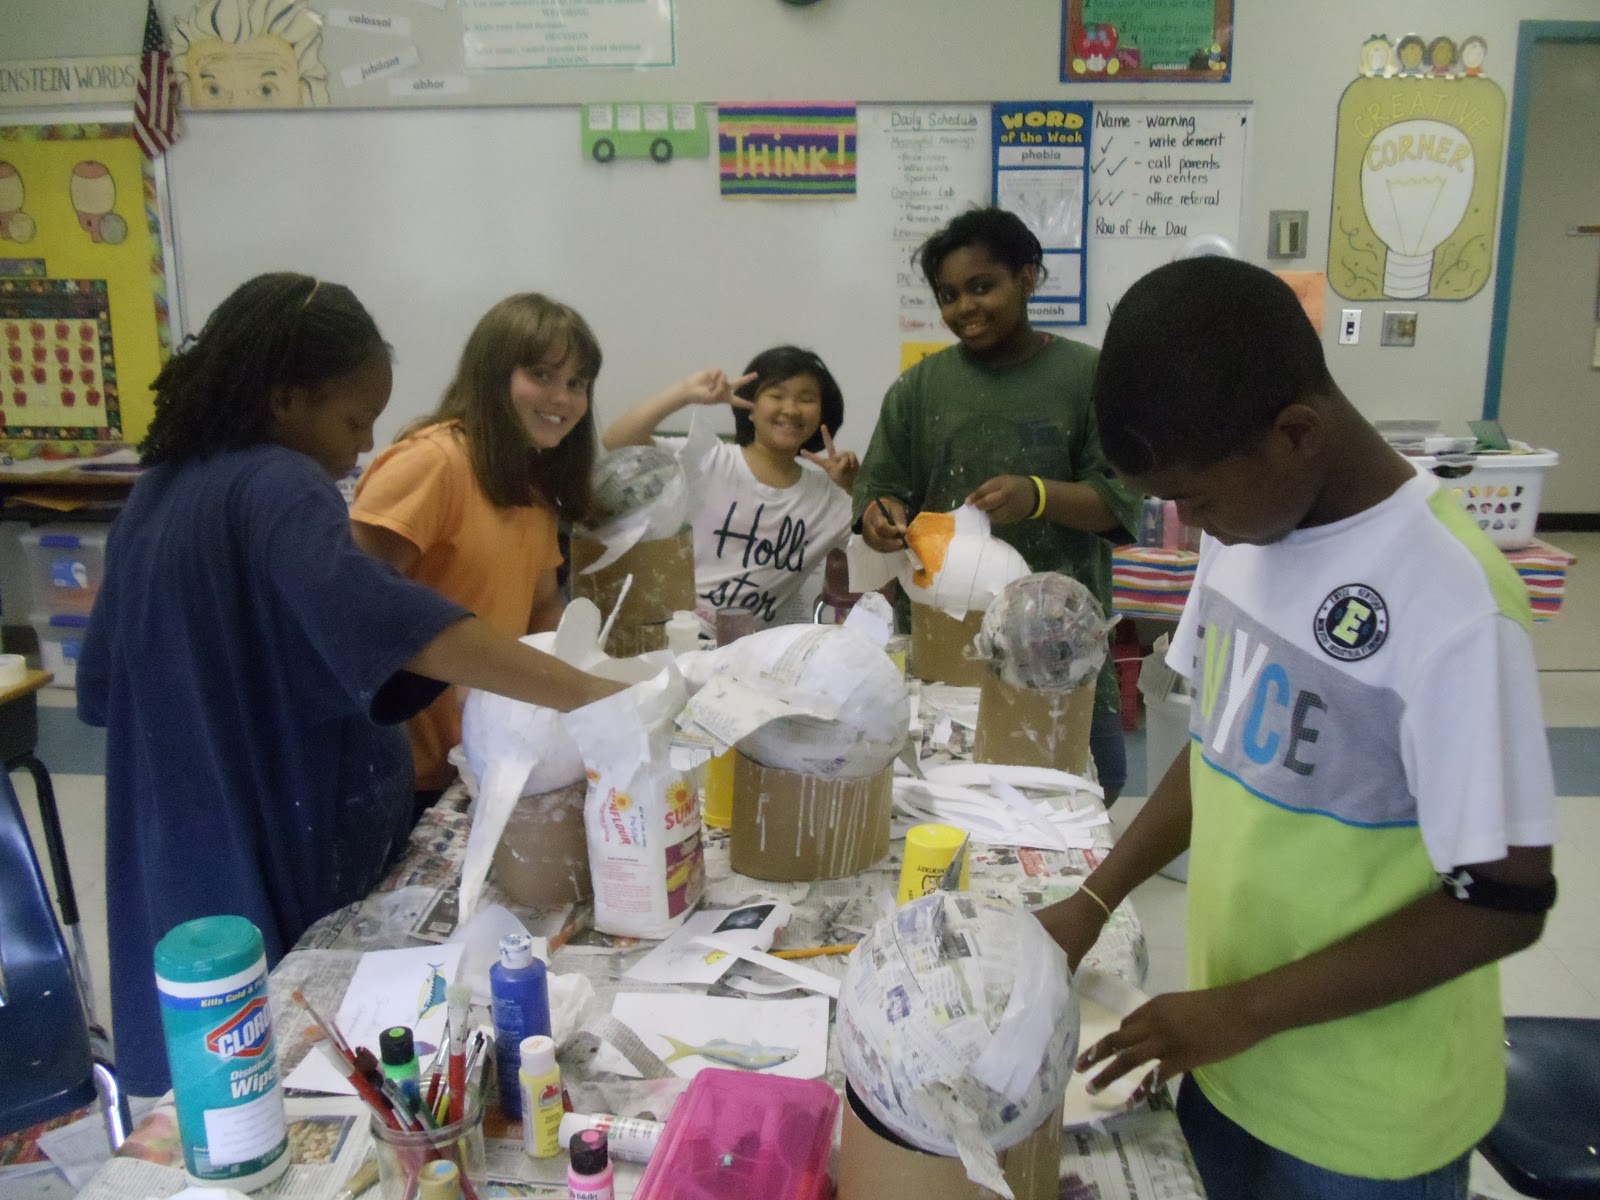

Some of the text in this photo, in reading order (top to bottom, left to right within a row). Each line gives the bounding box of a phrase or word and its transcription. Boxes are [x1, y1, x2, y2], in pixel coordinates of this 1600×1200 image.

[74, 64, 136, 89] WORDS
[891, 111, 922, 131] Daily
[1001, 110, 1084, 130] WORD
[1095, 110, 1131, 128] Name
[1354, 92, 1491, 139] CREATIVE
[1001, 131, 1082, 143] of the Week
[1149, 134, 1176, 148] write
[1021, 148, 1061, 162] phobia
[1365, 133, 1472, 173] CORNER
[1148, 155, 1171, 170] call
[1179, 153, 1221, 174] parents
[1150, 171, 1209, 184] no centers
[1146, 191, 1173, 206] office
[1180, 189, 1220, 206] referral
[1095, 216, 1115, 236] Row
[1119, 219, 1132, 235] of
[1138, 220, 1157, 236] the
[1028, 305, 1065, 316] monish
[713, 501, 809, 573] Holli
[1332, 598, 1372, 646] E
[916, 865, 945, 874] MENTARY
[200, 997, 224, 1008] Kills
[225, 989, 247, 1003] Cold
[218, 1000, 272, 1058] CLORO
[231, 1065, 277, 1099] Wipe
